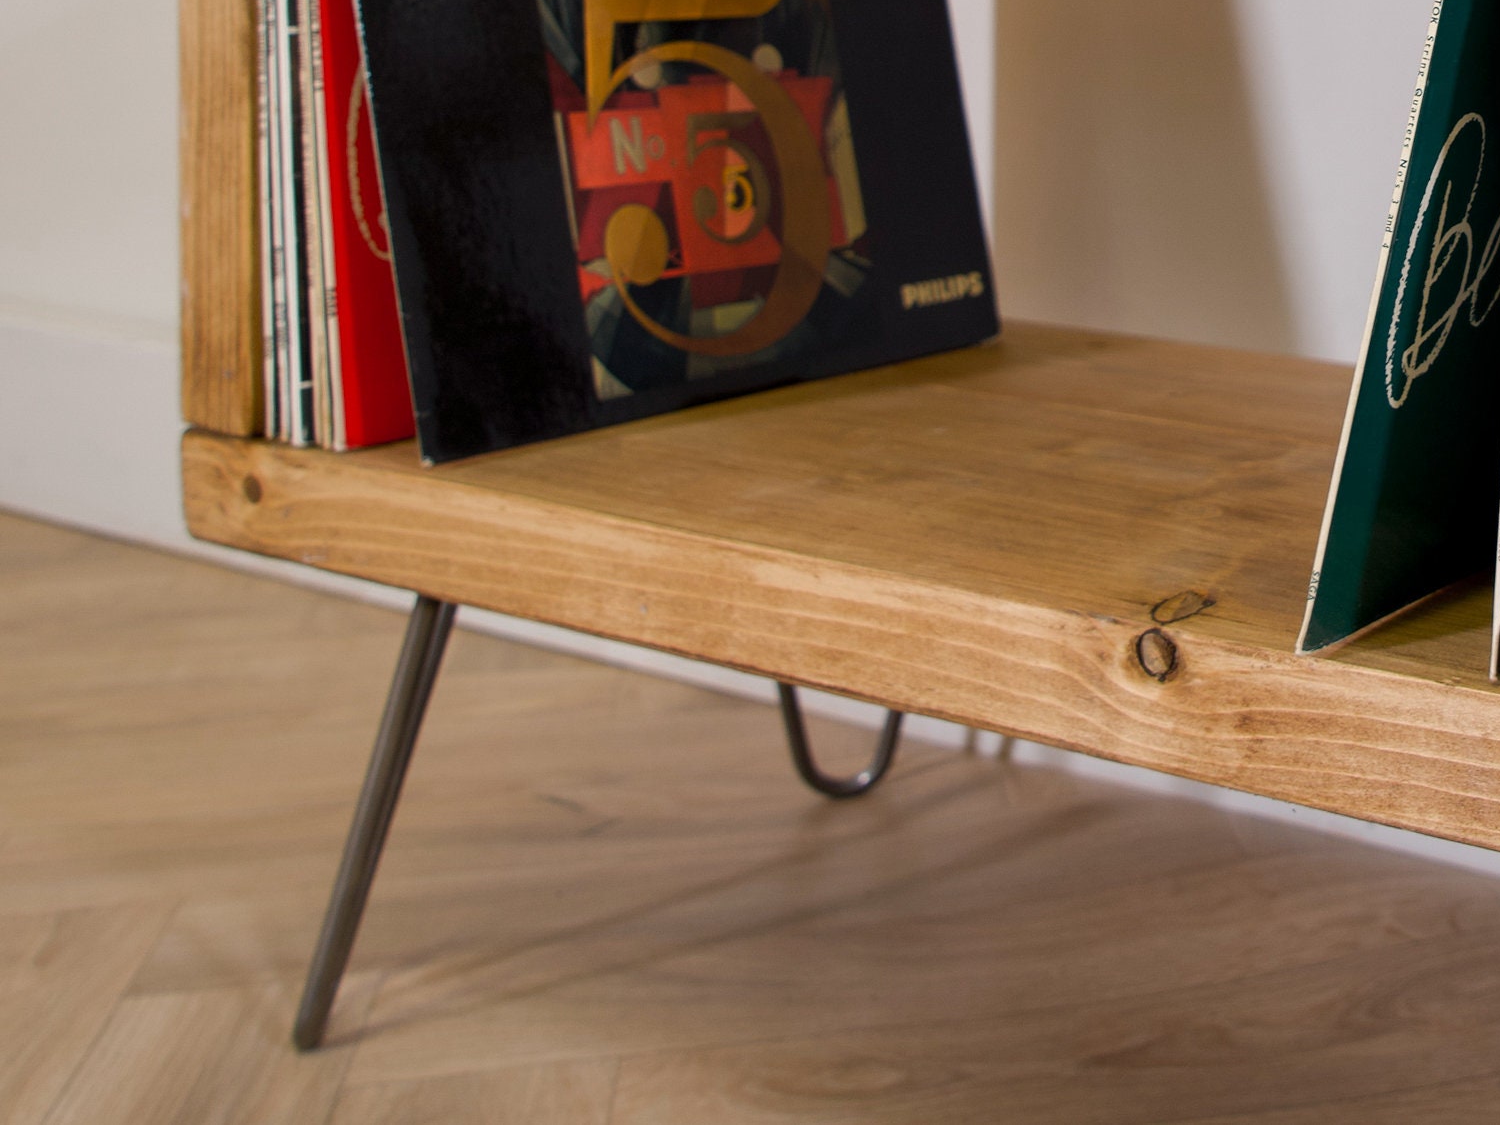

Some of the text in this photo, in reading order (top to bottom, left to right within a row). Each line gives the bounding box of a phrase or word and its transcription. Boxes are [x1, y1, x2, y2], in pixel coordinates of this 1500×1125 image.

[1417, 35, 1435, 77] String
[1402, 88, 1423, 148] Quartets
[1384, 214, 1396, 233] and
